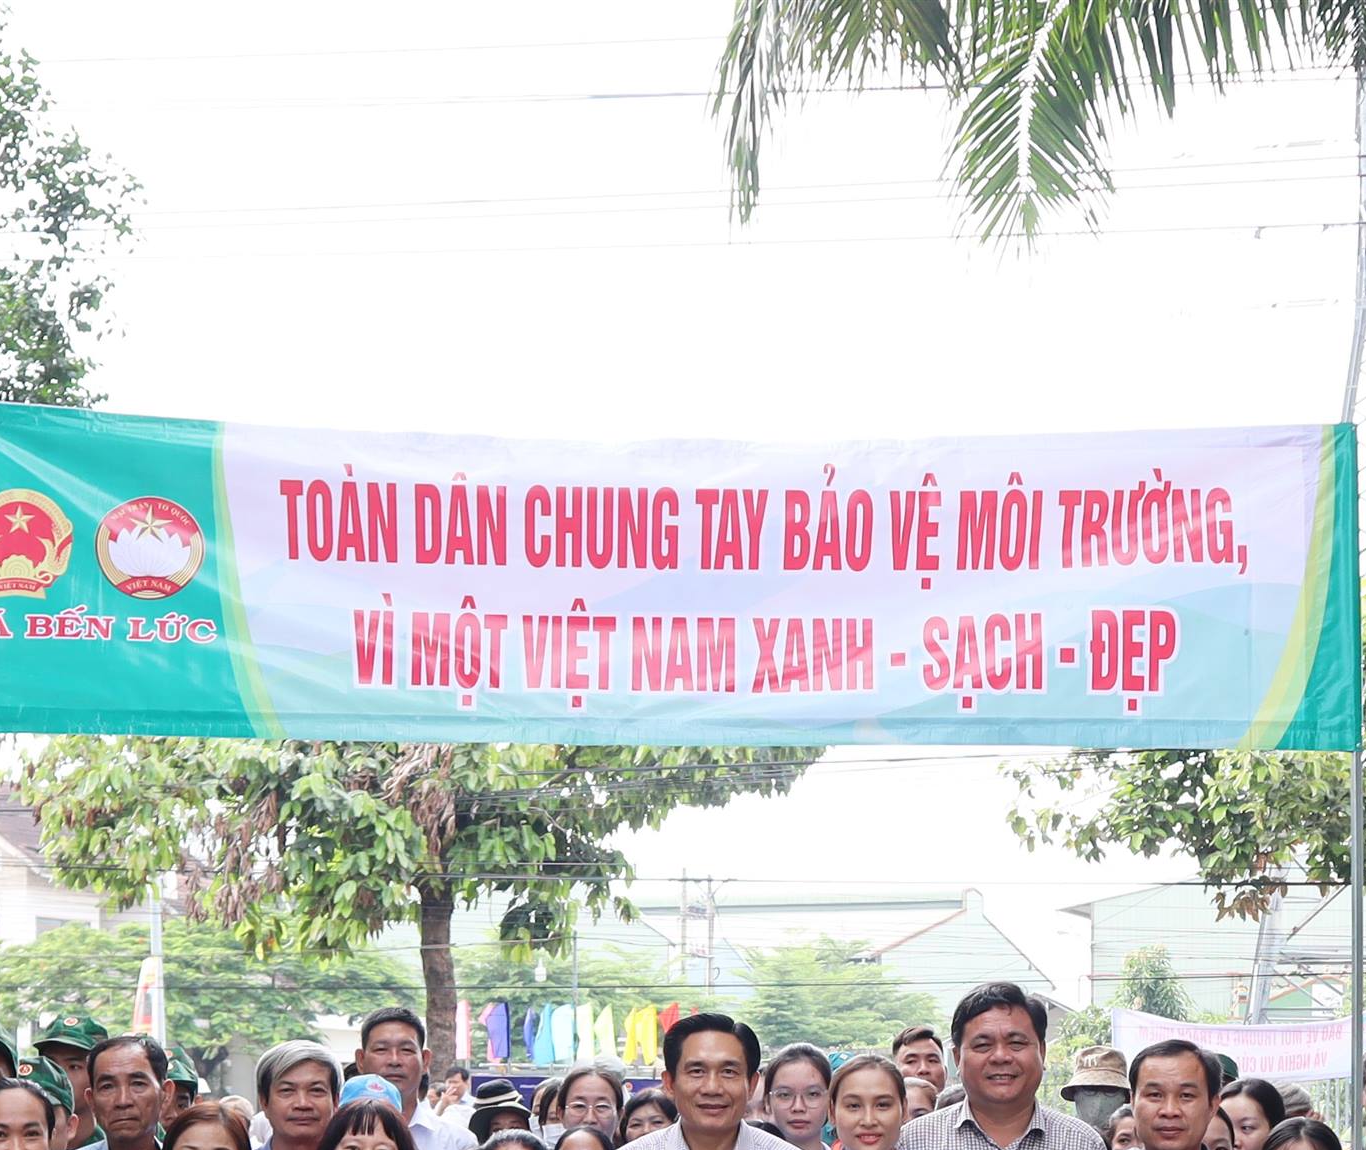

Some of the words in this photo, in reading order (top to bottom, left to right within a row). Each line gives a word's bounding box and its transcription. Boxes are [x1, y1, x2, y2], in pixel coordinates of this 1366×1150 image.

[279, 463, 399, 565] TOÀN
[415, 472, 508, 567] DÂN
[523, 484, 681, 572] CHUNG
[696, 488, 770, 571] TAY
[782, 463, 874, 573] BẢO
[889, 472, 943, 591] VỆ
[956, 471, 1044, 573] MÔI
[1058, 468, 1248, 576] TRƯỜNG,
[25, 605, 113, 640] BẾN
[127, 612, 218, 643] LỨC
[352, 593, 396, 687] VÌ
[410, 594, 510, 708] MỘT
[521, 597, 618, 709] VIỆT
[631, 615, 737, 693] NAM
[752, 617, 874, 693] XANH
[922, 613, 1044, 709] SẠCH
[1090, 610, 1177, 711] ĐẸP
